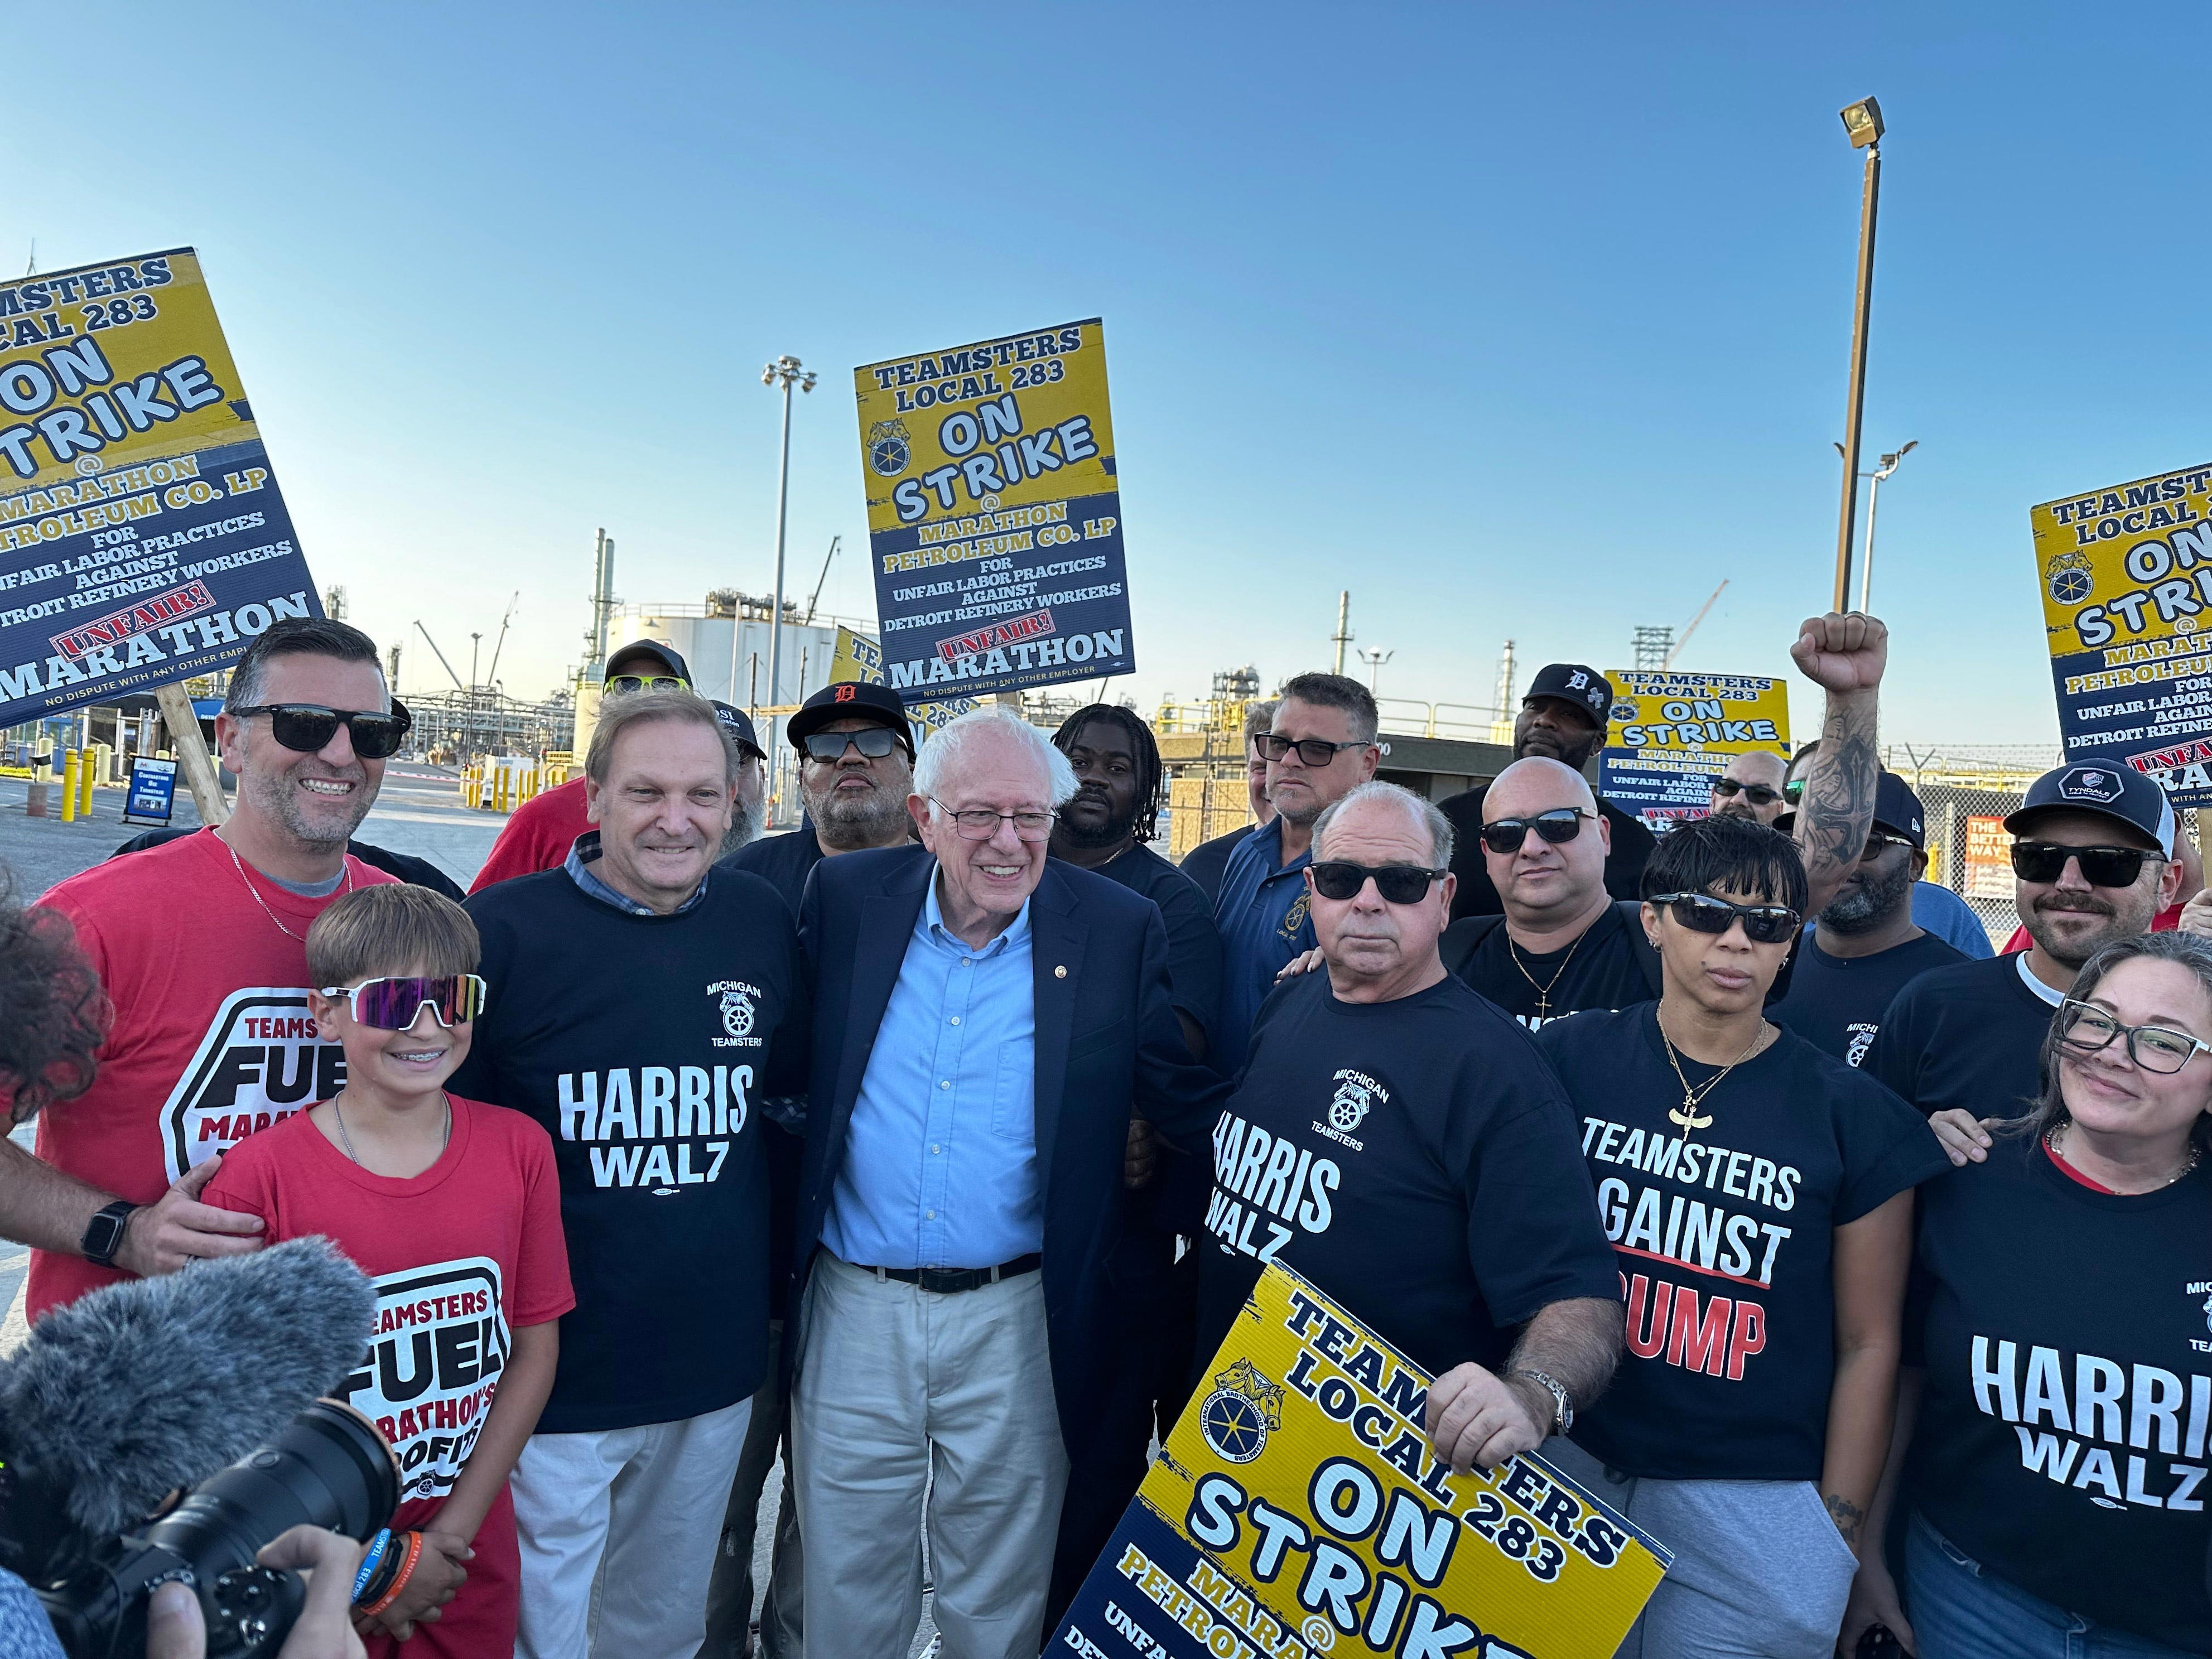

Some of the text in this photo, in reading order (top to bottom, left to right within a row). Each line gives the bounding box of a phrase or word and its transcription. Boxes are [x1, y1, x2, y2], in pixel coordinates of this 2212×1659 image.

[82, 294, 158, 333] 283
[0, 334, 113, 414] ON
[875, 327, 1081, 390] TEAMSTERS
[896, 360, 1065, 413] LOCAL 283
[941, 393, 1021, 456] ON
[75, 454, 103, 476] @
[894, 416, 1098, 522] STRIKE
[0, 454, 200, 524] MARATHON
[164, 481, 223, 510] CO.
[223, 467, 267, 496] LP
[980, 494, 1000, 512] @
[91, 526, 138, 549] FOR
[919, 501, 1067, 545] MARATHON
[2075, 501, 2197, 545] LOCAL
[62, 544, 141, 574] LABOR
[144, 512, 266, 553] PRACTICES
[883, 517, 1116, 575] PETROLEUM CO. LP
[68, 570, 182, 609] REFINERY
[180, 540, 293, 580] WORKERS
[75, 551, 178, 590] AGAINST
[893, 556, 1106, 602] UNFAIR LABOR PRACTICES
[980, 557, 1013, 573] FOR
[884, 583, 1121, 632] DETROIT REFINERY WORKERS
[962, 582, 1037, 605] AGAINST
[59, 586, 208, 655] UNFAIR!
[943, 613, 1049, 659] UNFAIR!
[2174, 616, 2197, 634] @
[0, 591, 311, 703] MARATHON
[889, 629, 1124, 689] MARATHON
[45, 696, 62, 707] NO
[66, 682, 116, 701] DISPUTE
[118, 671, 149, 687] WITH
[152, 665, 175, 678] ANY
[179, 652, 218, 671] OTHER
[938, 684, 973, 696] DISPUTE
[975, 679, 996, 691] WITH
[999, 677, 1016, 687] ANY
[1018, 673, 1047, 685] OTHER
[1049, 666, 1095, 679] EMPLOYER
[1619, 673, 1771, 690] TEAMSTERS
[1632, 685, 1758, 701] LOCAL 283
[2175, 677, 2212, 692] FOR
[1662, 700, 1723, 721] ON
[2077, 691, 2212, 720] UNFAIR LABOR
[1623, 720, 1779, 746] STRIKE
[2068, 727, 2144, 748] DETROIT
[1607, 758, 1725, 776] PETROLEUM
[1612, 776, 1661, 785] UNFAIR
[1662, 779, 1707, 789] LABOR
[1683, 774, 1708, 782] FOR
[1603, 790, 1658, 800] DETROIT
[2069, 788, 2110, 797] TYNDALE
[2171, 794, 2196, 803] WITH
[1970, 821, 1997, 833] THE
[1969, 845, 2001, 858] WAY
[706, 981, 762, 999] MICHIGAN
[245, 1018, 318, 1039] TEAMS
[711, 1037, 762, 1047] TEAMSTERS
[1847, 1023, 1878, 1034] MICHI
[558, 1065, 754, 1141] HARRIS
[1333, 1069, 1389, 1104] MICHIGAN
[1311, 1121, 1363, 1152] TEAMSTERS
[1212, 1110, 1341, 1233] HARRIS
[1582, 1117, 1801, 1211] TEAMSTERS
[1204, 1186, 1293, 1264] WALZ
[1285, 1347, 1566, 1584] LOCAL 283
[2013, 1426, 2208, 1511] WALZ
[1309, 1456, 1461, 1588] ON
[358, 1568, 371, 1582] 283
[1301, 1614, 1336, 1651] @
